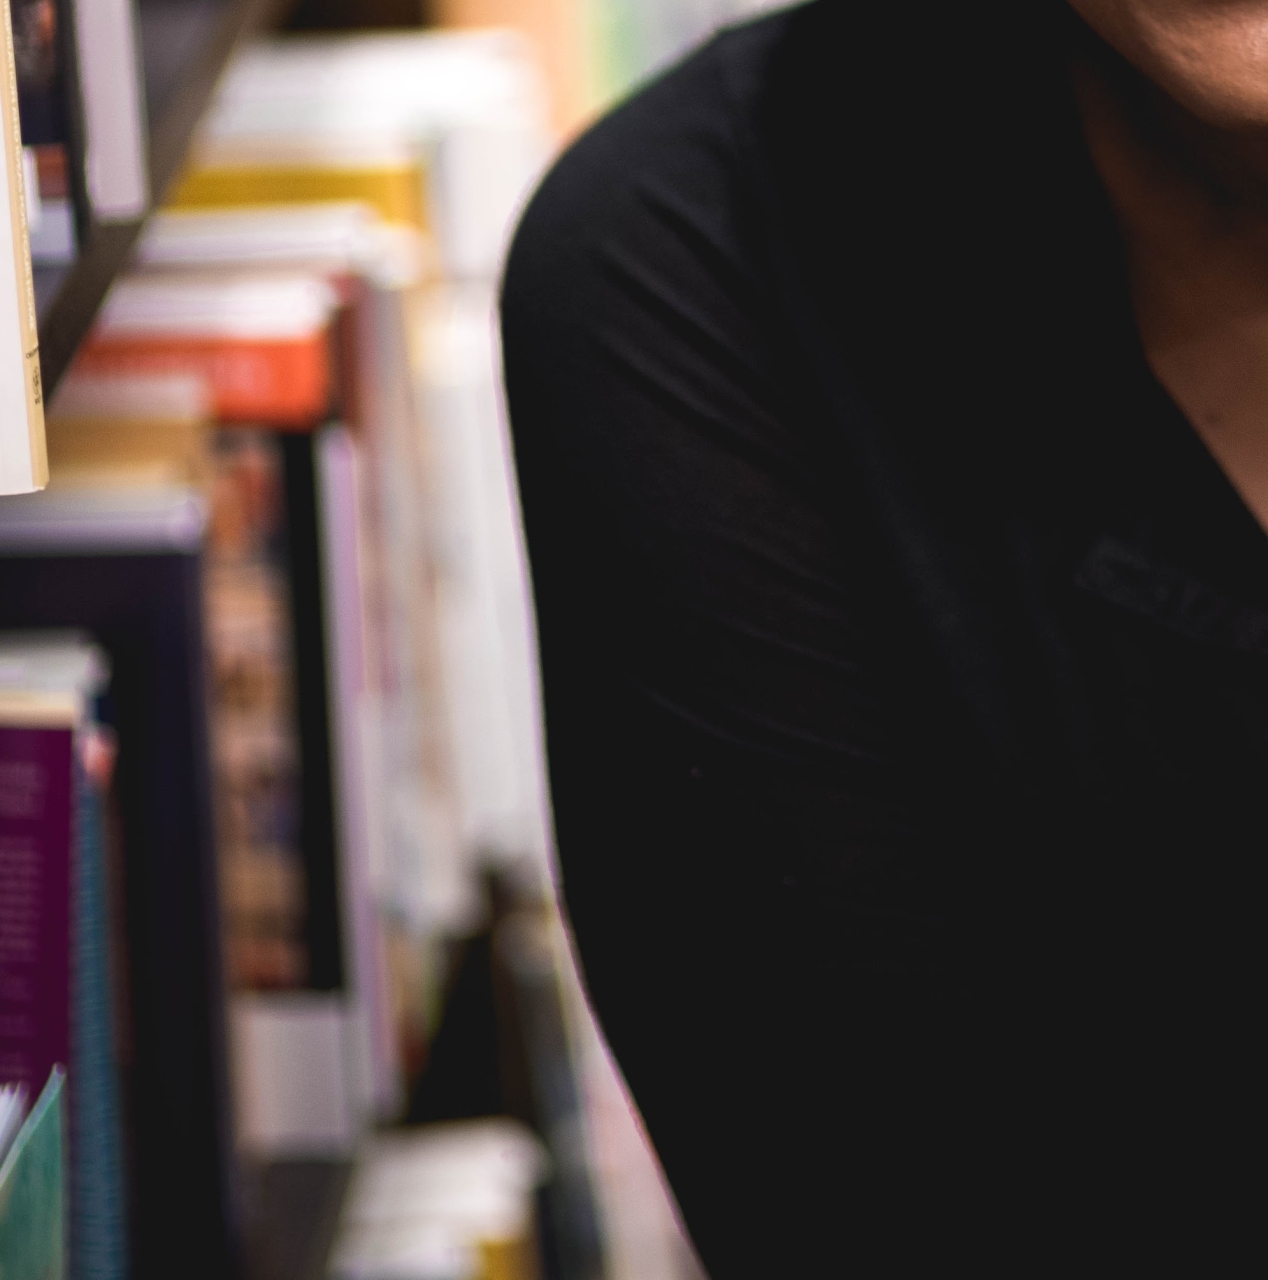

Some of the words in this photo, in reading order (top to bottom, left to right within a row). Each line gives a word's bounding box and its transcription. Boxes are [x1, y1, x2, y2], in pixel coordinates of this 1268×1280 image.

[15, 145, 23, 193] IDEAS
[22, 230, 30, 277] YOUR
[26, 279, 34, 331] HOME
